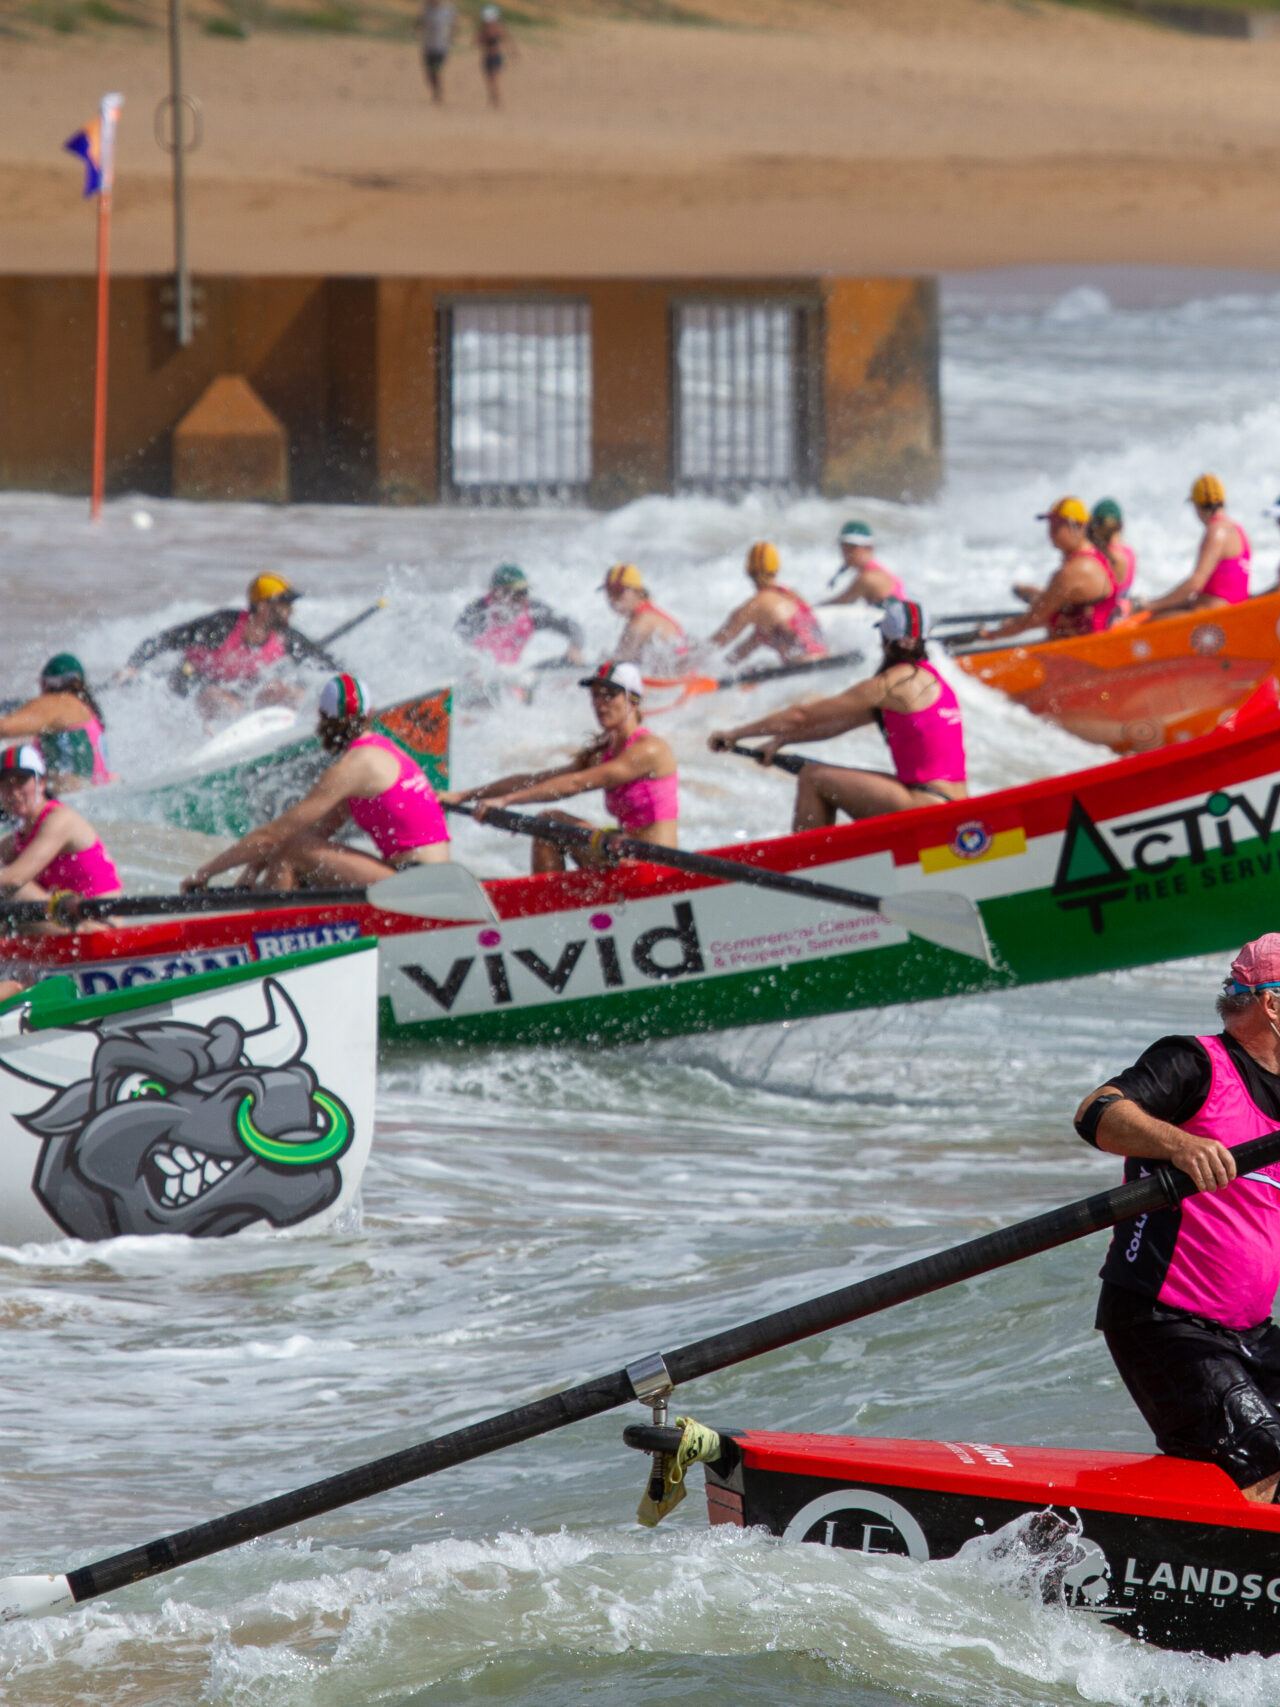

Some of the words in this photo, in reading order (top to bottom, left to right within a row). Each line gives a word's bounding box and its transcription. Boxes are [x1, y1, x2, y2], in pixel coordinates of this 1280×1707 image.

[400, 899, 706, 1012] vivid
[710, 926, 814, 954] Commercial
[713, 955, 727, 969] &
[730, 944, 802, 967] Property
[807, 928, 879, 950] Services
[55, 958, 249, 997] DCON
[1126, 1165, 1151, 1263] COLLY
